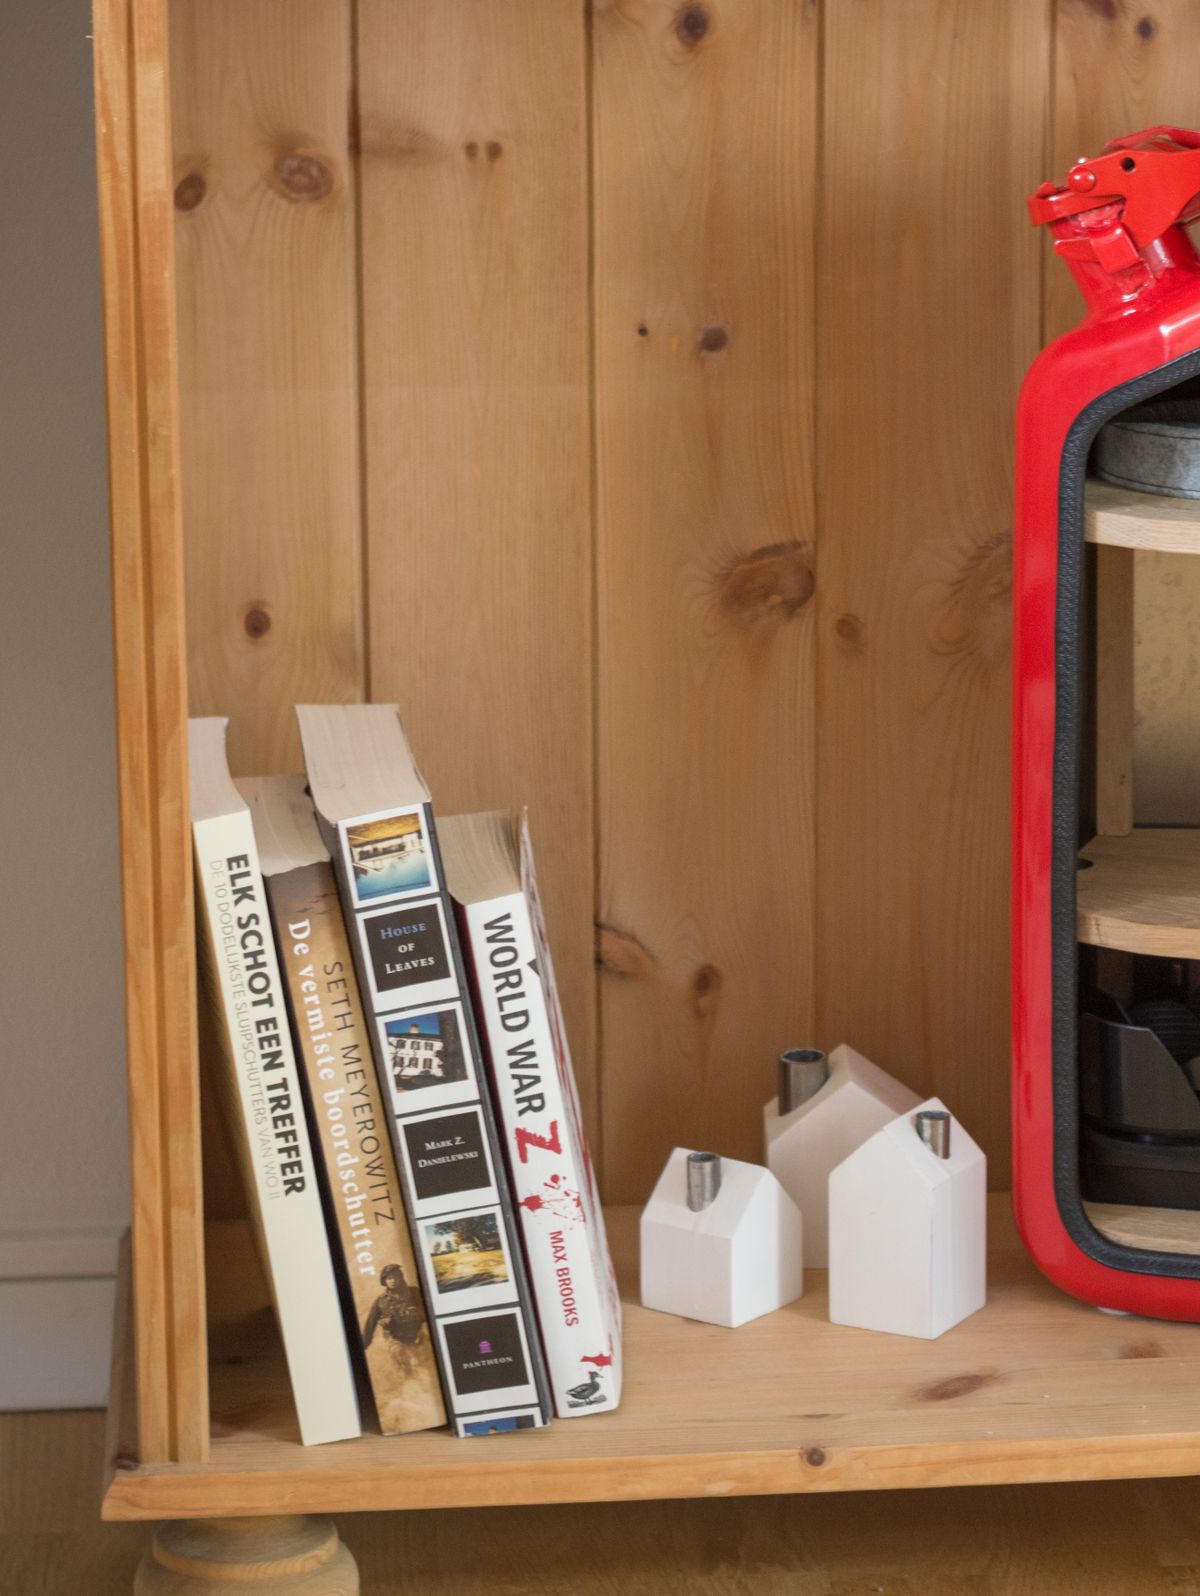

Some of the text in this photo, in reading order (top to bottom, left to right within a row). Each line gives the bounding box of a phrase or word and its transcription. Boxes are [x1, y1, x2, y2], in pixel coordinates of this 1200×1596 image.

[210, 860, 224, 879] DE
[214, 883, 228, 899] 10
[380, 923, 427, 940] HOUSE
[217, 902, 246, 999] DODELIJKSTE
[397, 943, 415, 953] OF
[385, 957, 435, 974] LEAVES
[226, 853, 306, 1197] ELK SCHOT EEN TREFFER
[483, 912, 562, 1164] WORLD WAR Z
[234, 1001, 267, 1126] SLUIPSCHUTTERS
[288, 918, 377, 1276] De vermiste boordschutter
[323, 961, 395, 1226] SETH MEYEROWITZ
[257, 1127, 273, 1158] VAN
[424, 1140, 453, 1151] MARK
[417, 1151, 479, 1168] DANIELEWSKI
[264, 1161, 279, 1188] WO
[549, 1230, 579, 1328] MAX BROOKS
[462, 1356, 513, 1369] PANTHEON
